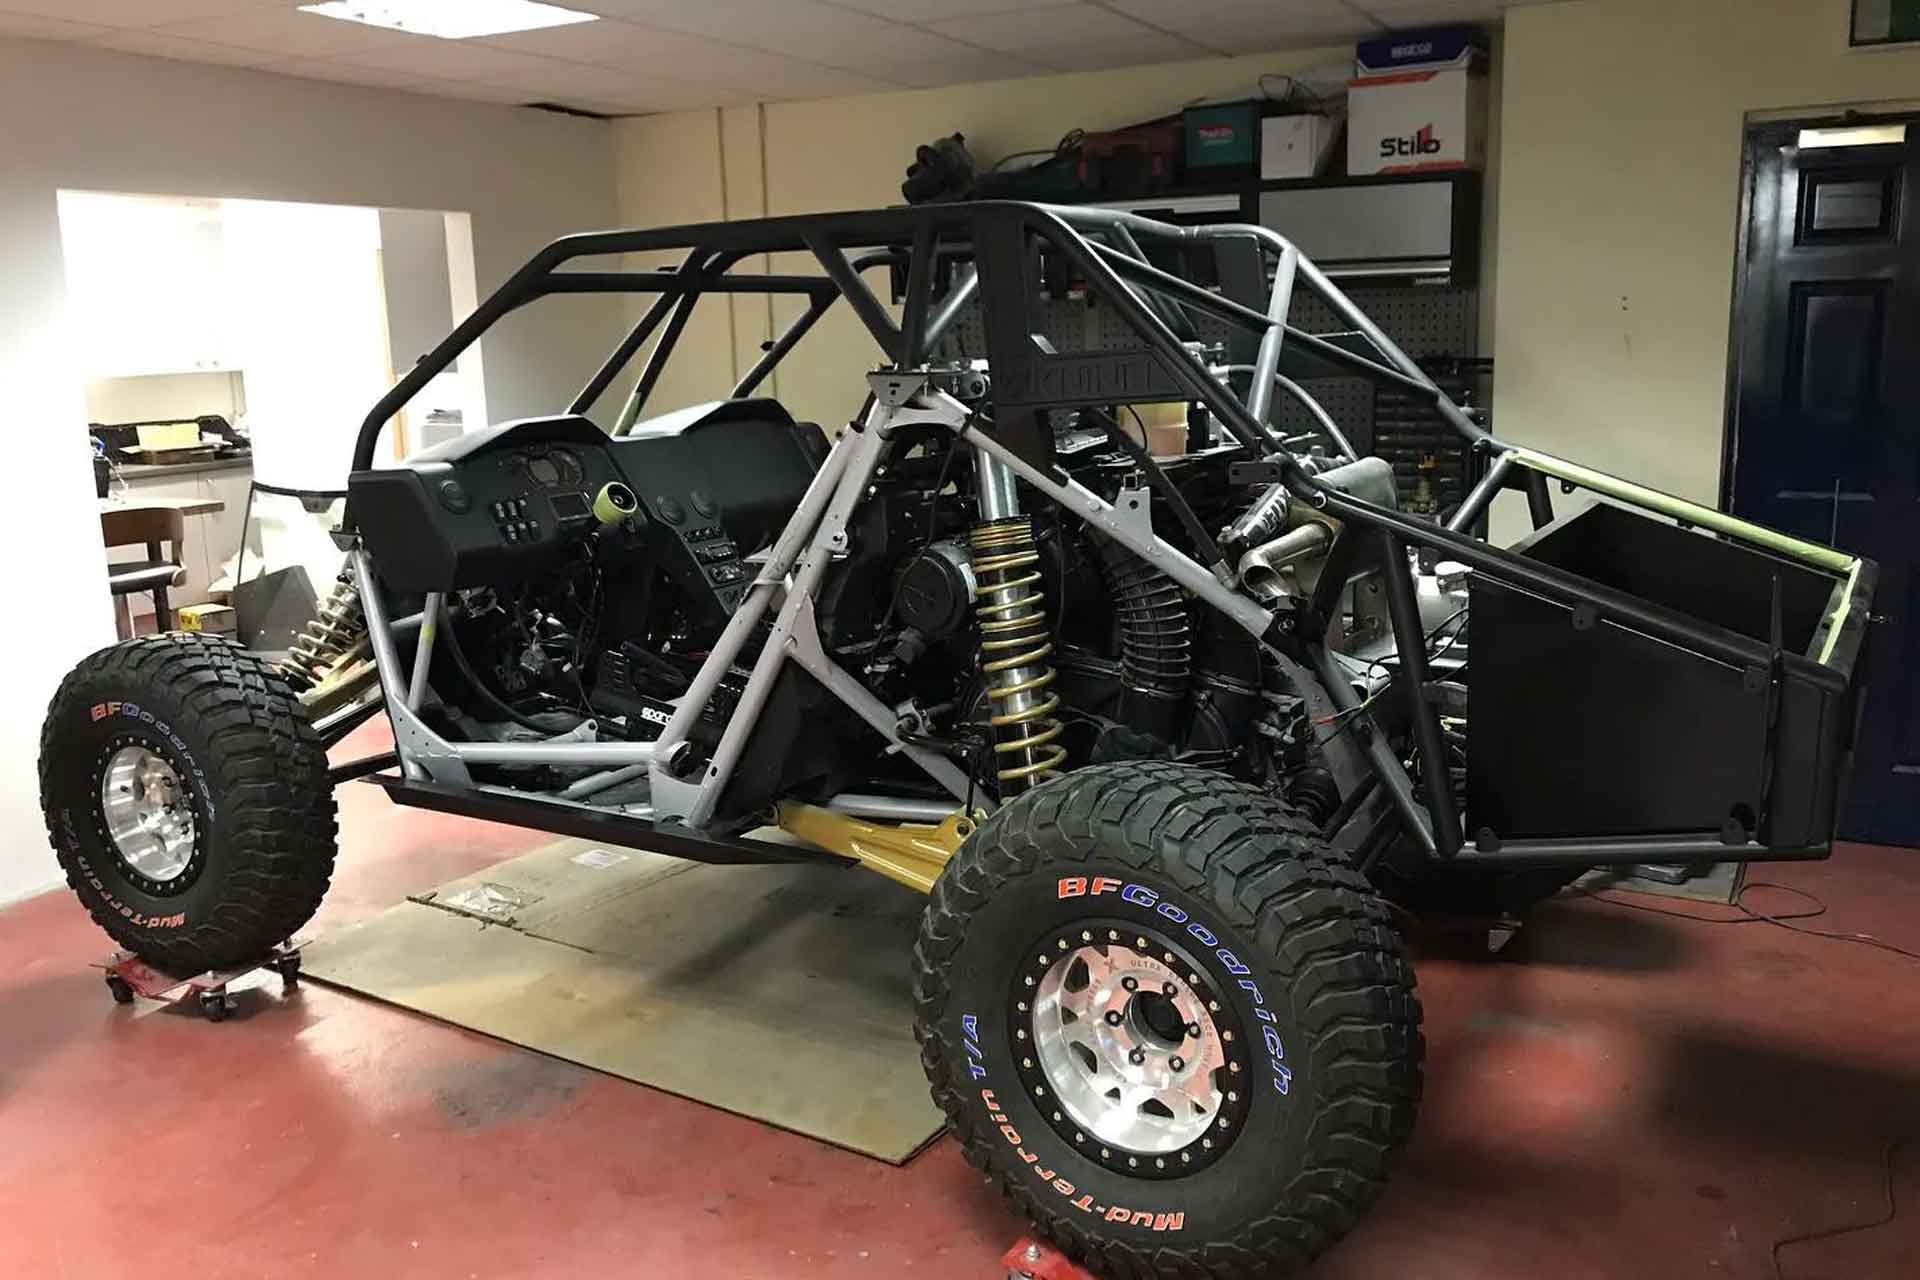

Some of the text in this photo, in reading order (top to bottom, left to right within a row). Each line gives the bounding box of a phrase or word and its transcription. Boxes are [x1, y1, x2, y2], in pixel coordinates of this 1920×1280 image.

[1380, 126, 1441, 157] Stilo
[91, 702, 216, 823] BFGoodrich
[1058, 877, 1292, 1095] BFGoodrich
[962, 1014, 1185, 1231] Mud-Terrain T/A
